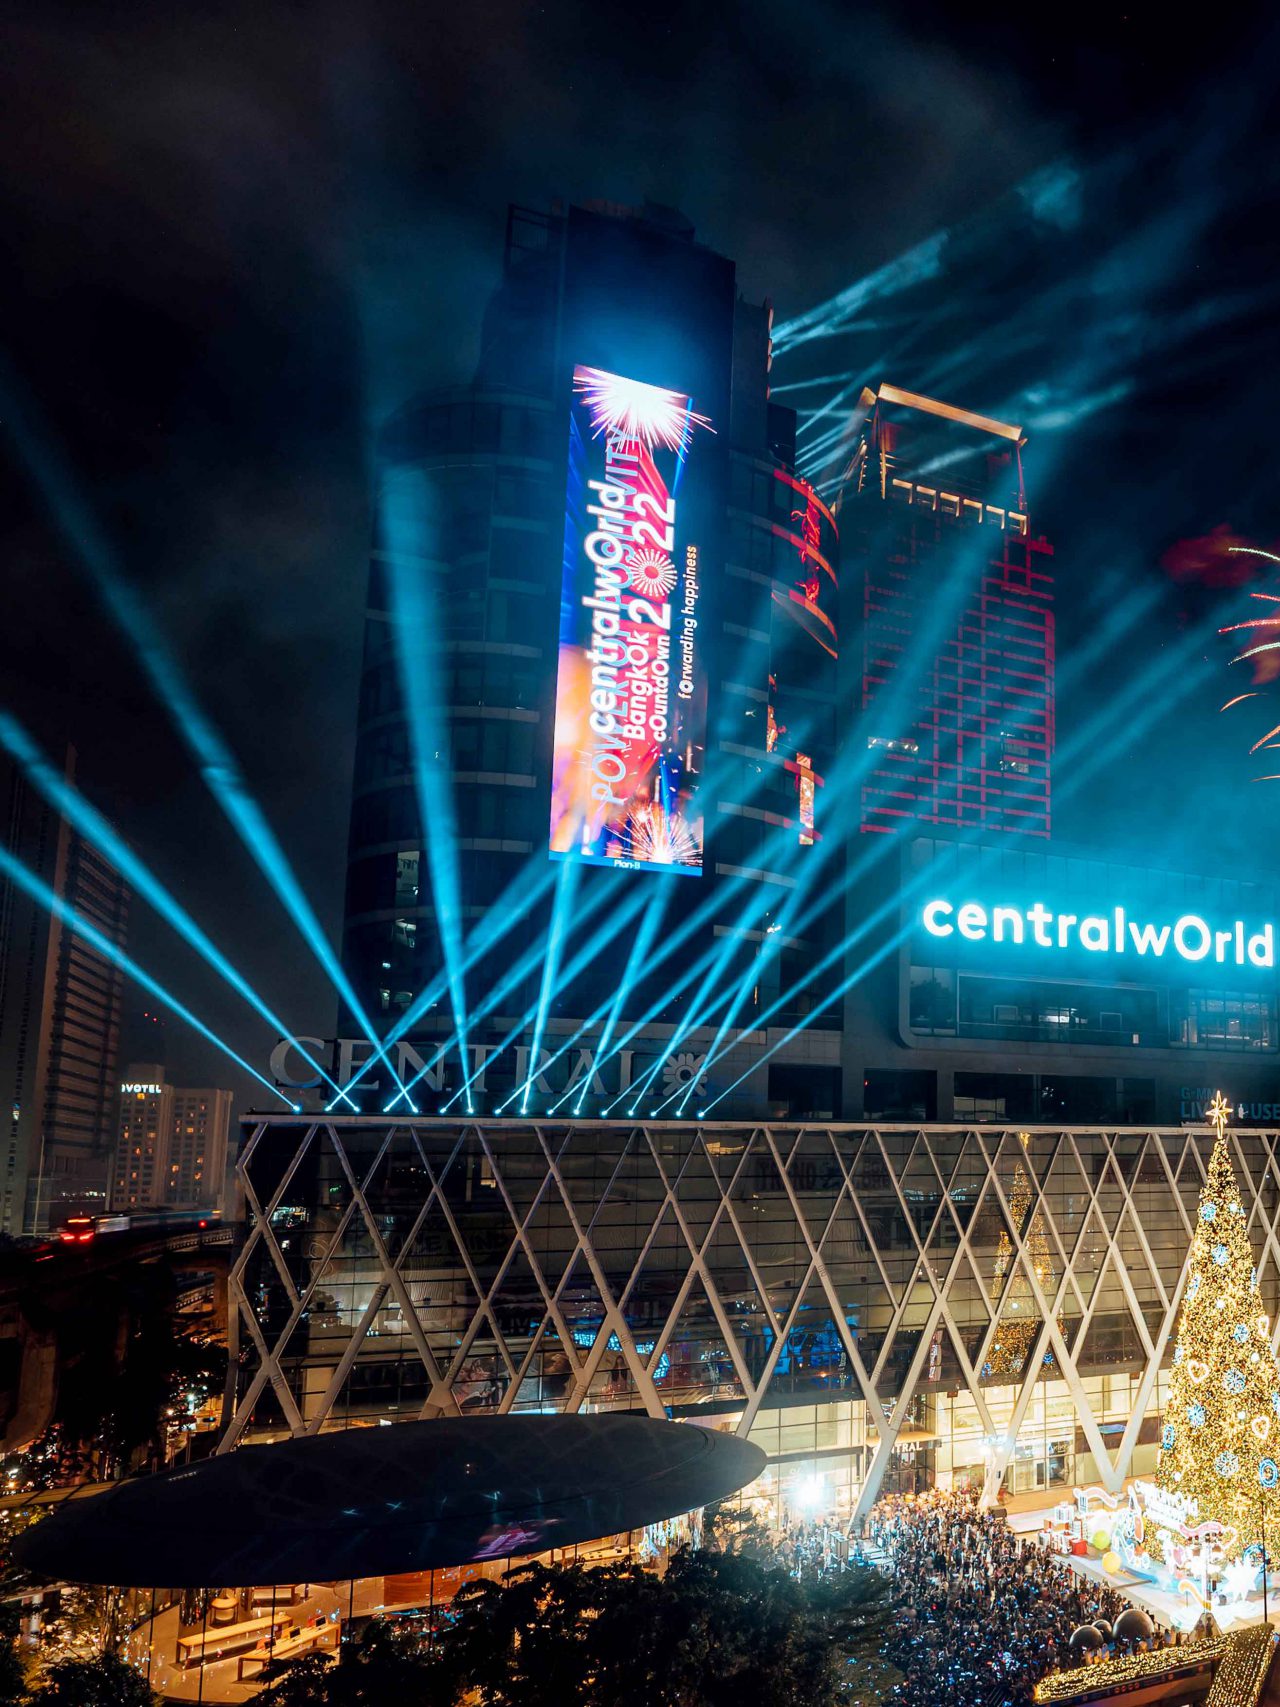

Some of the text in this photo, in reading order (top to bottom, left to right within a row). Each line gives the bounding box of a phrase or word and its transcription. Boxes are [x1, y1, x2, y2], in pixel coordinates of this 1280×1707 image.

[582, 479, 626, 735] centralwOrld
[678, 546, 698, 700] fOrwarding happiness
[622, 630, 654, 741] BangkOk
[649, 635, 671, 742] cOuntdOwn
[923, 900, 1273, 967] centralwOrld
[270, 1036, 654, 1097] CENTRAL
